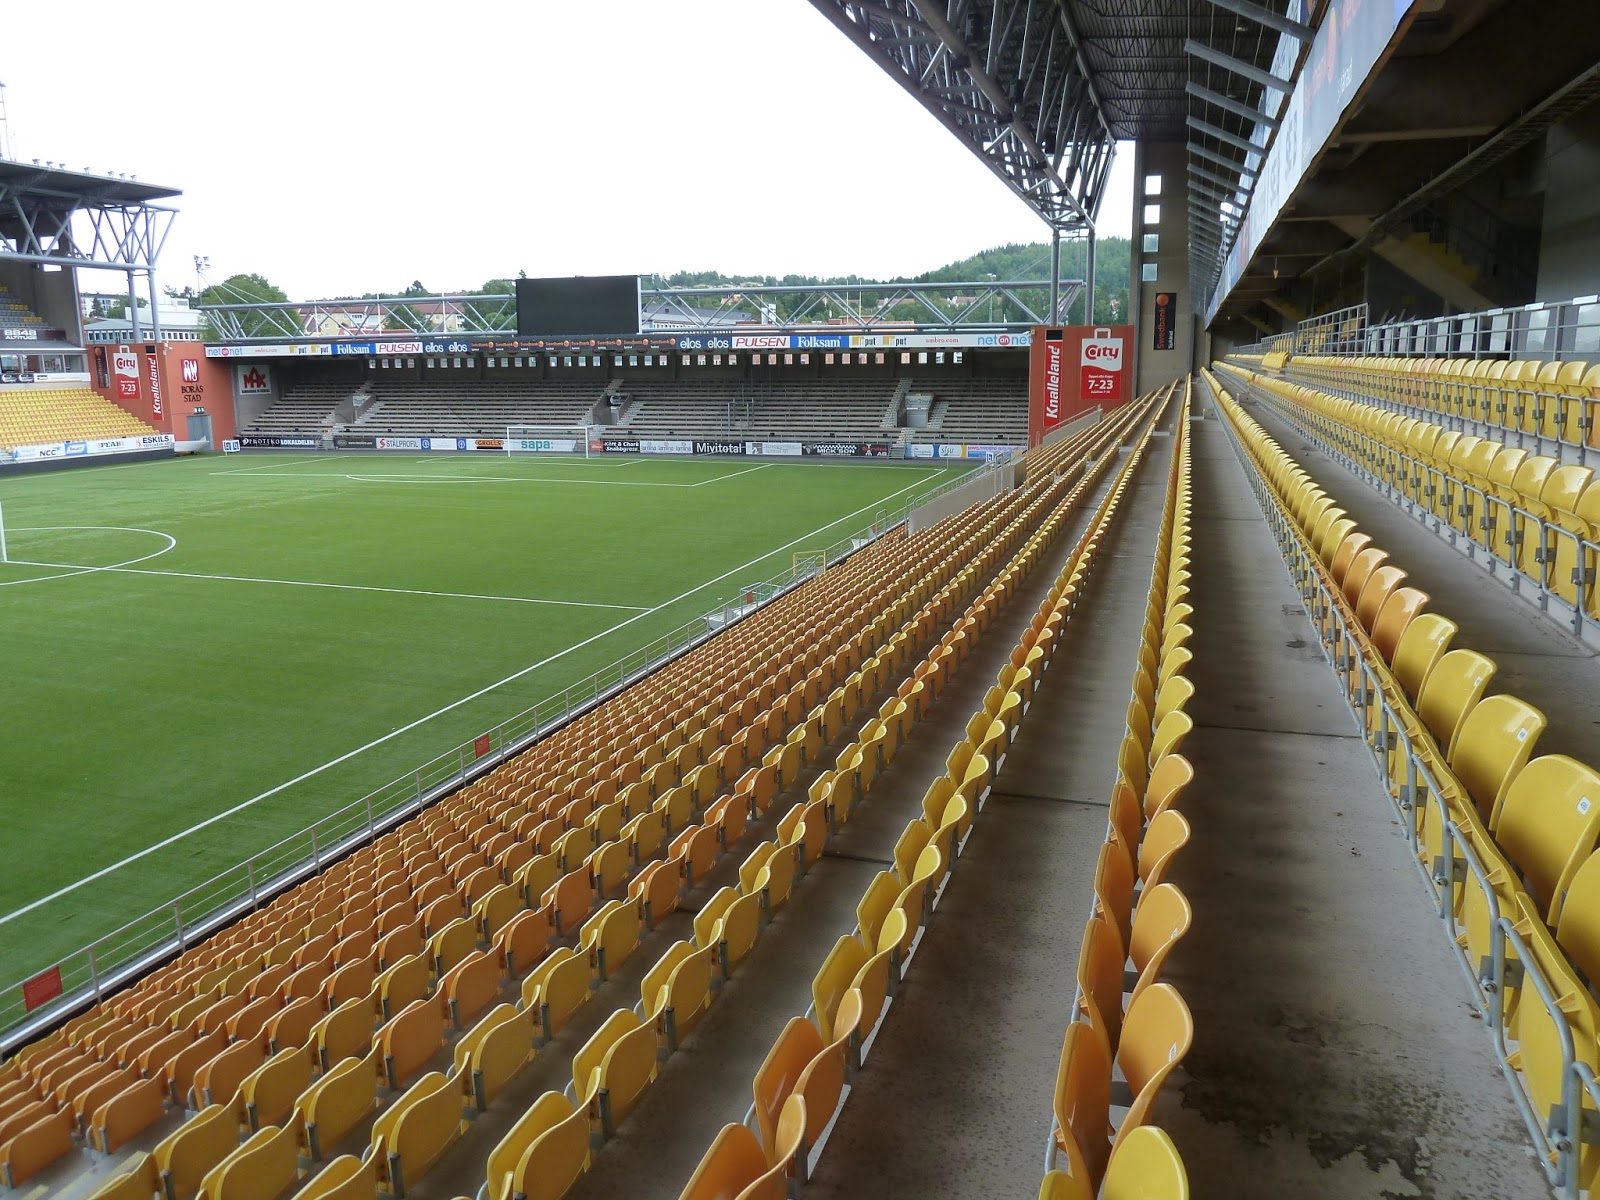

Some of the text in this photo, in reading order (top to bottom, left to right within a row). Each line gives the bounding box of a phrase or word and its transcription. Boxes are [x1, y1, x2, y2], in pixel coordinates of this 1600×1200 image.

[735, 337, 787, 347] PULSEN
[797, 336, 841, 348] Folksam
[337, 343, 371, 354] Folksam
[1085, 344, 1119, 360] City
[116, 357, 136, 369] City
[243, 366, 267, 389] MAX
[1046, 345, 1060, 419] Knalleland
[120, 384, 136, 392] 7-23
[1088, 379, 1113, 390] 7-23
[40, 449, 56, 457] NCC
[696, 442, 742, 454] Mivitotal
